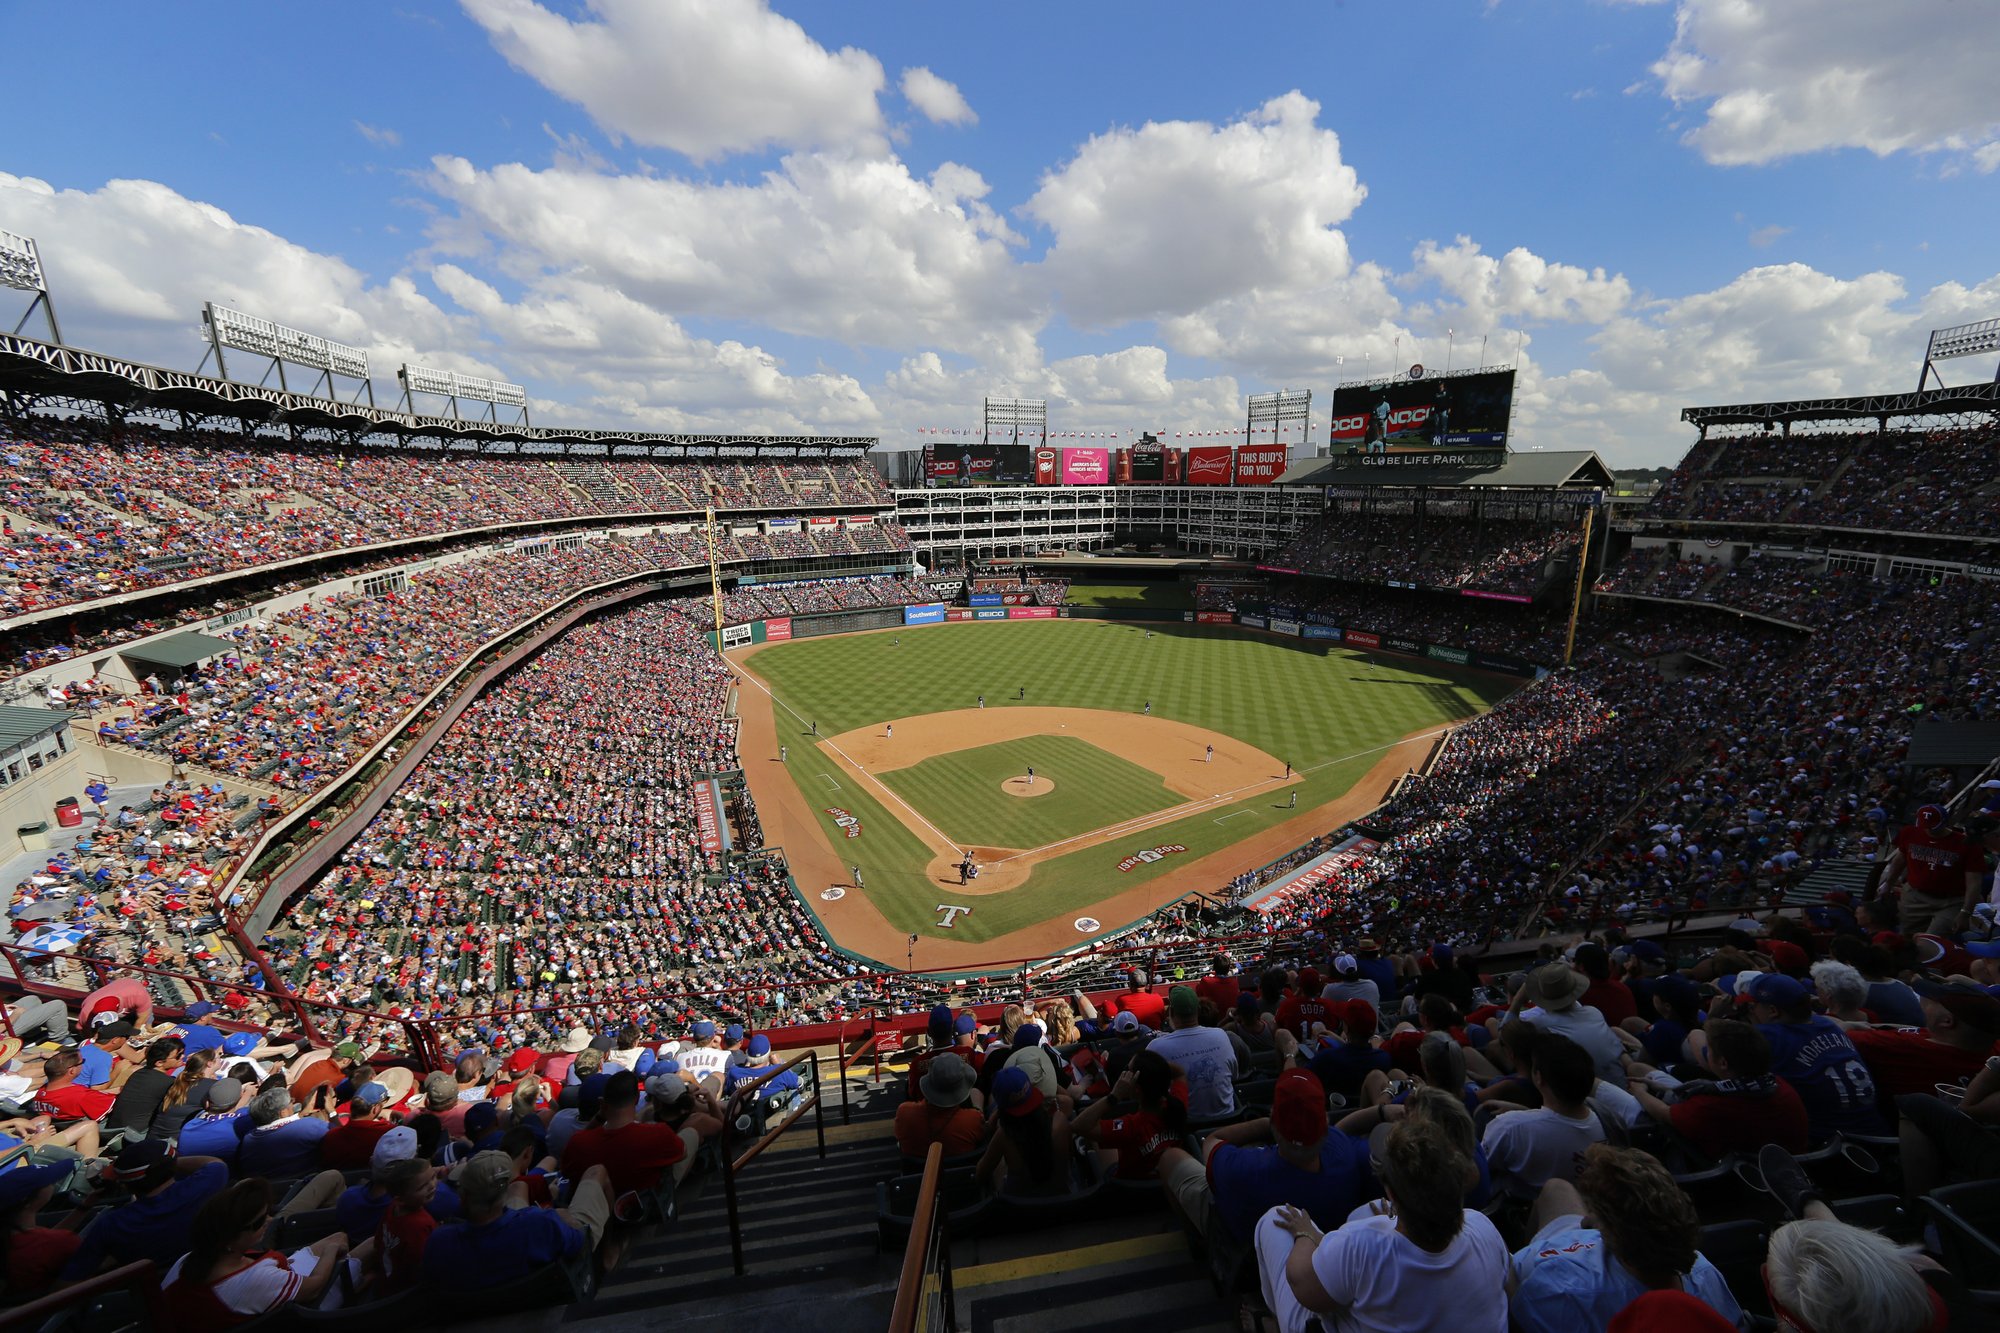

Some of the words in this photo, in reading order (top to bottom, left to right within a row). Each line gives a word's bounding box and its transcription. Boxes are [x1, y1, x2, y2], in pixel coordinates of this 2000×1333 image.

[1240, 453, 1257, 463] THIS
[1259, 451, 1284, 463] BUD'S
[1362, 456, 1401, 466] GLOBE
[1404, 456, 1429, 464] LIFE
[1433, 455, 1466, 464] PARK
[1193, 460, 1226, 470] Budweiser
[1239, 465, 1254, 476] FOR
[1256, 465, 1274, 476] YOU.
[1554, 491, 1596, 503] PAINTS
[930, 581, 963, 591] NOCO
[726, 626, 748, 635] TRUCK
[726, 631, 749, 640] WORLD
[1437, 649, 1468, 661] National
[696, 793, 712, 811] TEXAS
[71, 808, 79, 816] T
[699, 812, 716, 839] RANGERS
[1117, 856, 1141, 872] 1994
[1154, 844, 1186, 855] 2019
[1279, 872, 1320, 896] TEXAS
[936, 904, 971, 928] T
[1300, 1003, 1325, 1015] ODOR
[685, 1055, 718, 1068] GALLO
[734, 1076, 772, 1089] MURY
[33, 1100, 60, 1117] ELTRE
